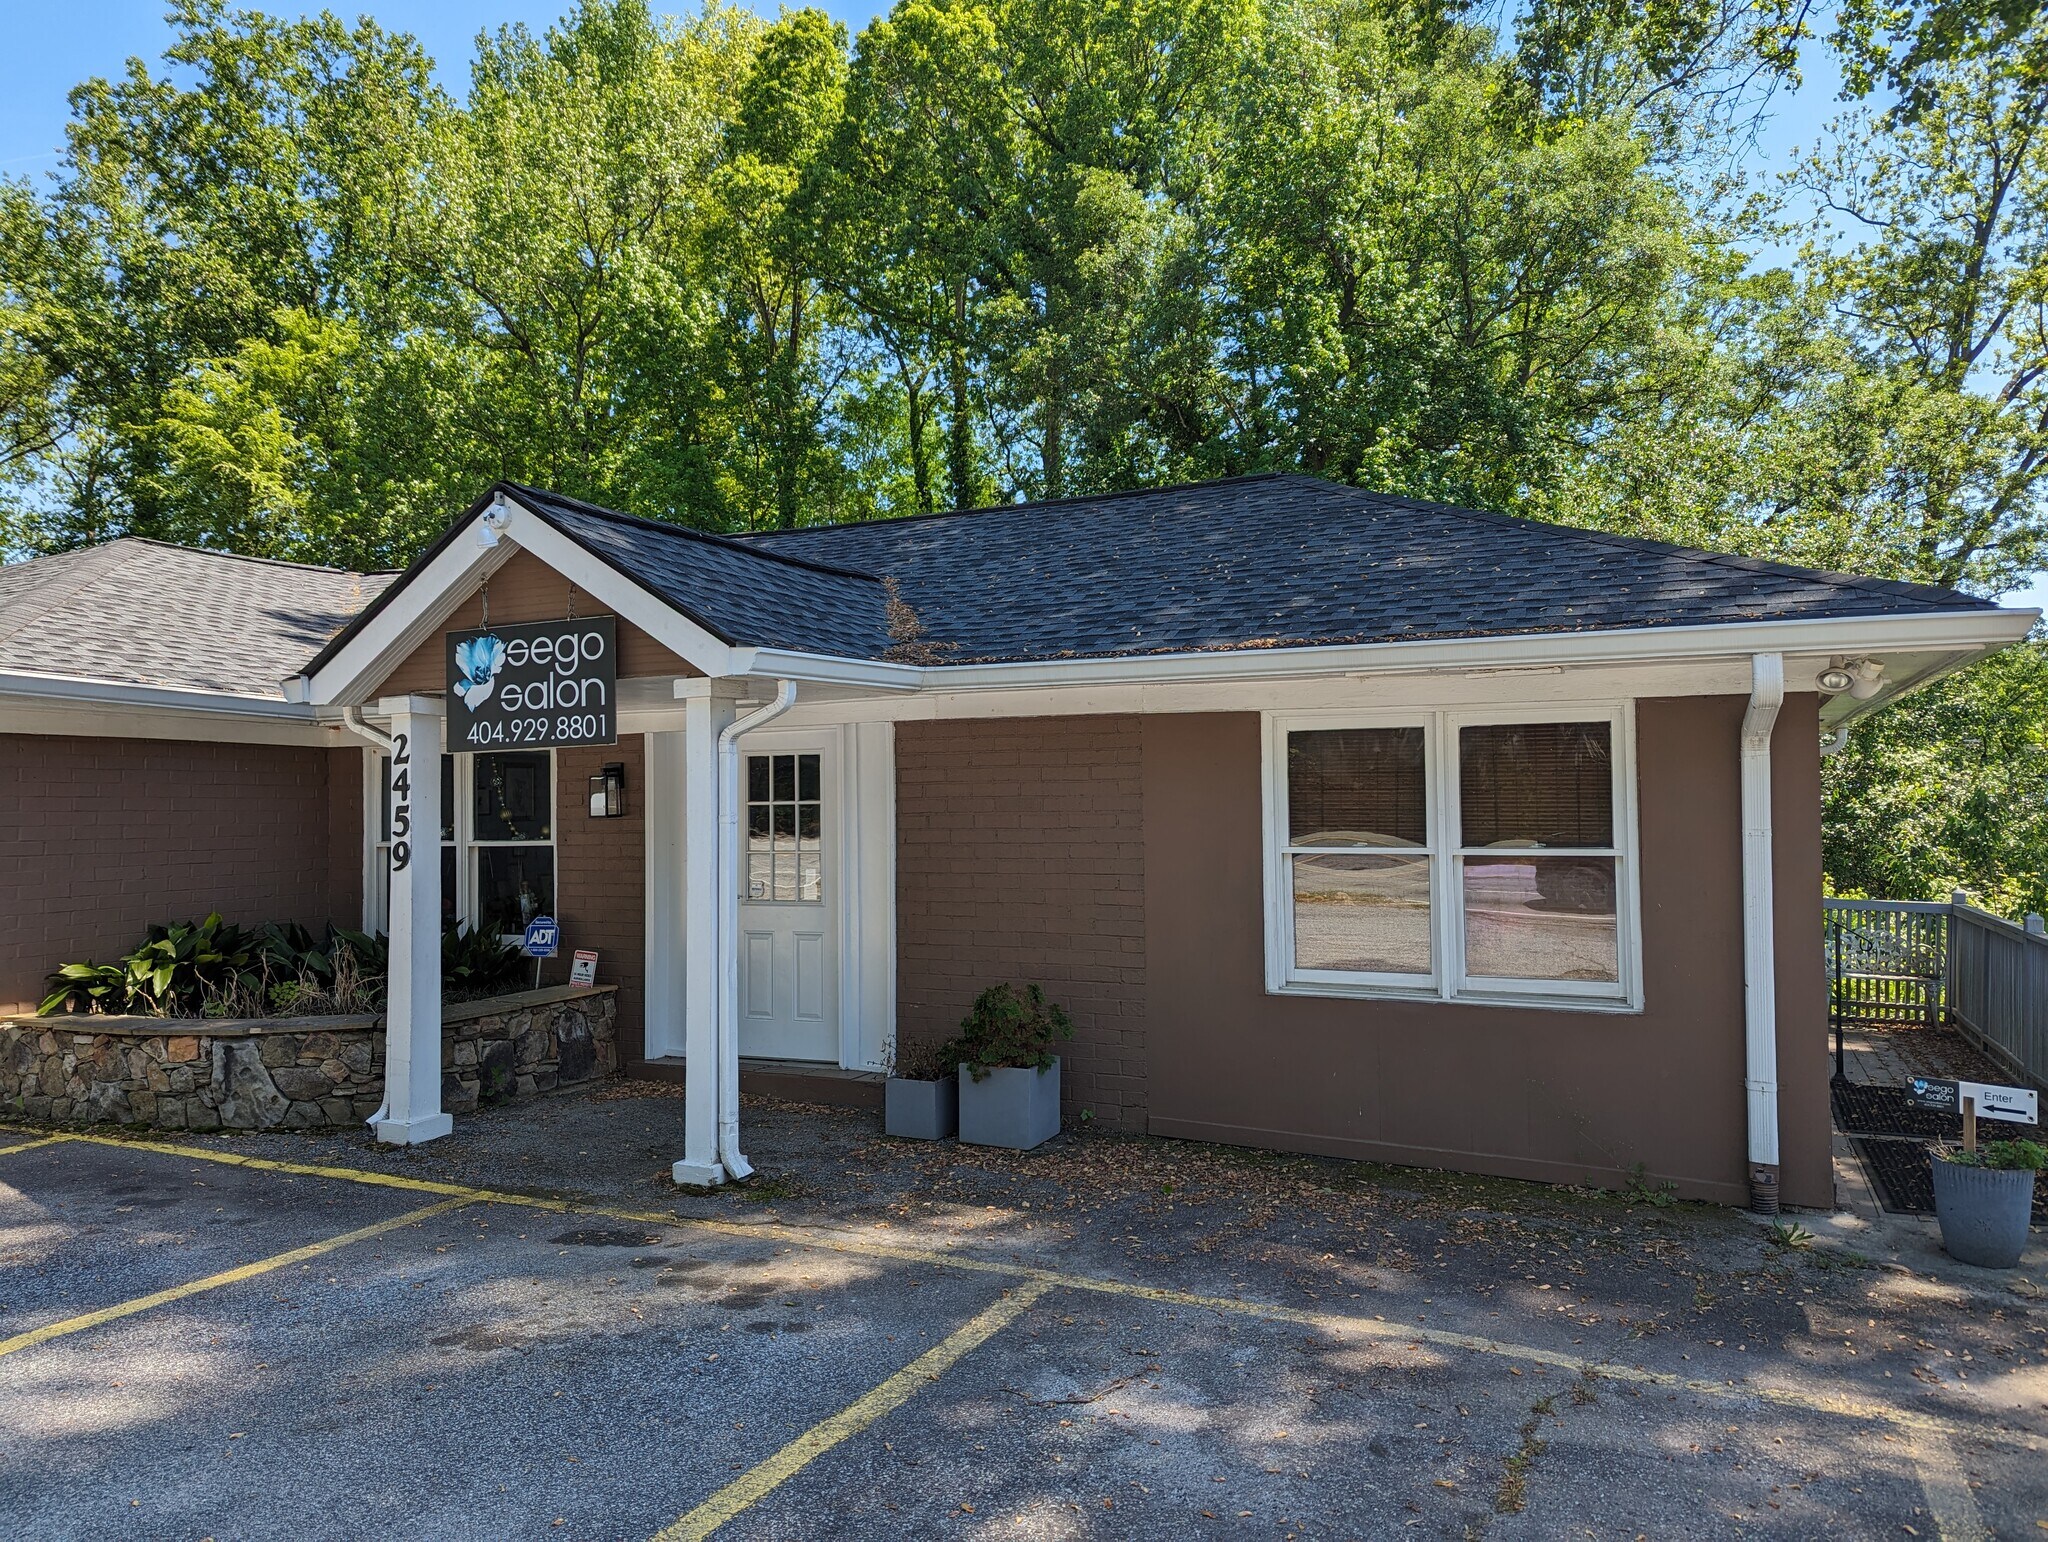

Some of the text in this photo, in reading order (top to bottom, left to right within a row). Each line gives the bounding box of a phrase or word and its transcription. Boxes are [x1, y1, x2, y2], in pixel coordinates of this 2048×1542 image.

[506, 632, 605, 676] sego
[500, 671, 606, 712] salon
[466, 714, 606, 745] 404.929.8801
[391, 733, 411, 872] 2459
[529, 929, 555, 945] ADT
[1925, 1092, 1955, 1103] salon
[1927, 1084, 1954, 1095] sego
[1984, 1091, 2014, 1104] Enter
